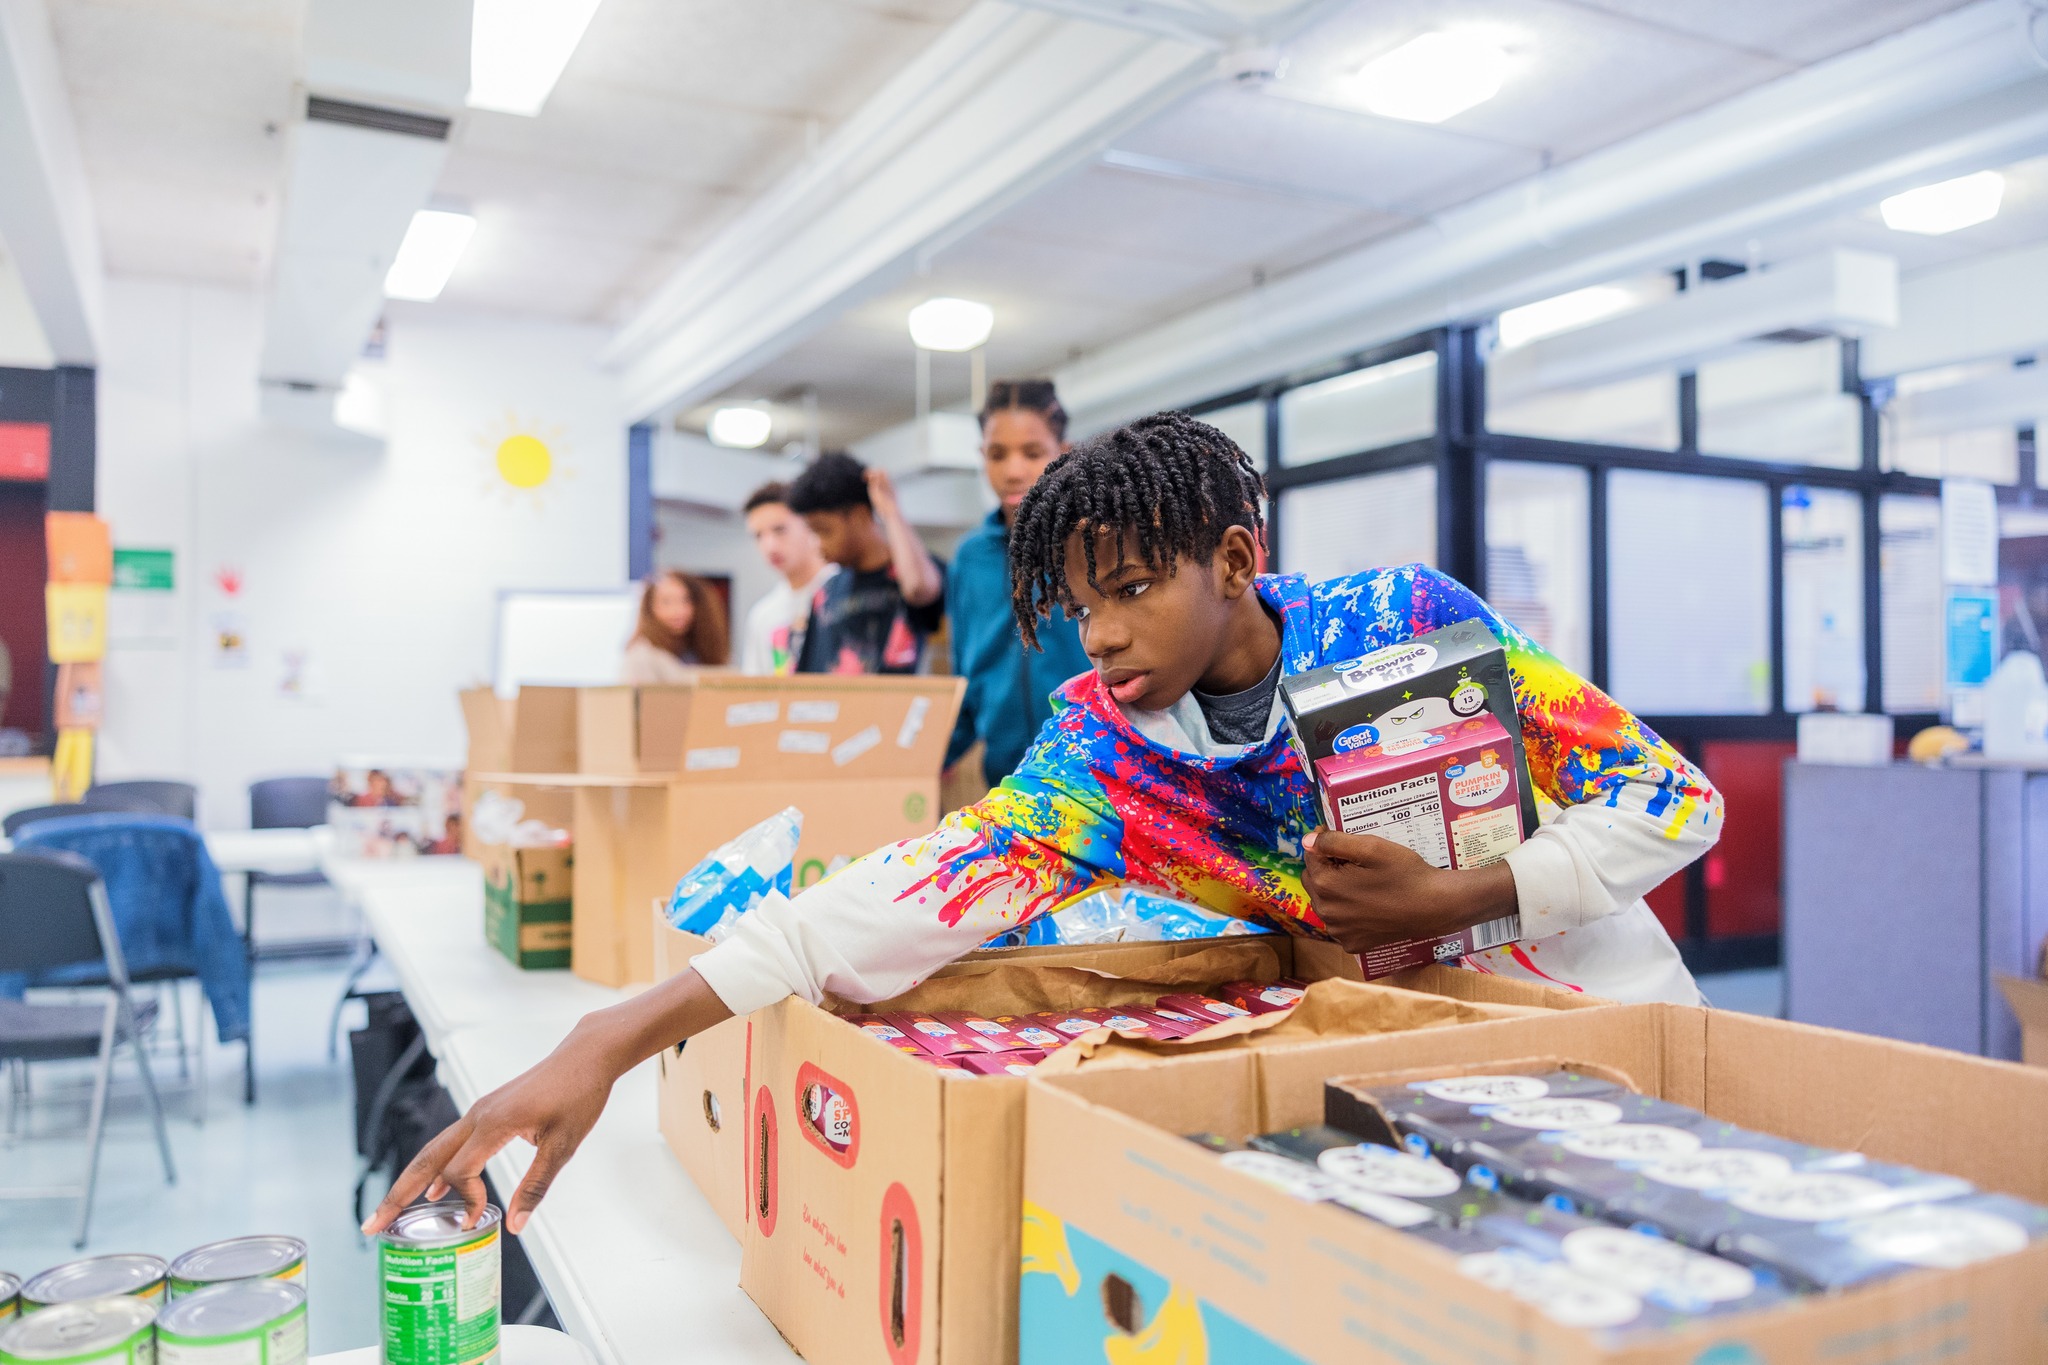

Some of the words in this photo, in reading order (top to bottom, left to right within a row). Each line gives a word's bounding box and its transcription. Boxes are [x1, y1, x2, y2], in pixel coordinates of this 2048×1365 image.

[1346, 648, 1427, 683] Brownie
[1463, 695, 1474, 704] 13
[1337, 728, 1372, 747] Great
[1346, 737, 1373, 750] Value
[1454, 771, 1501, 790] PUMPKIN
[1455, 784, 1481, 796] SPICE
[1483, 778, 1502, 788] BAR
[1341, 786, 1398, 807] Nutrition
[1400, 775, 1437, 791] Facts
[1471, 788, 1488, 797] MIX
[1342, 809, 1362, 818] Serving
[1390, 796, 1413, 806] package
[1345, 820, 1379, 834] Calories
[1391, 810, 1411, 821] 100
[1421, 802, 1440, 813] 140
[384, 1254, 424, 1266] Nutrition
[425, 1254, 455, 1266] Facts
